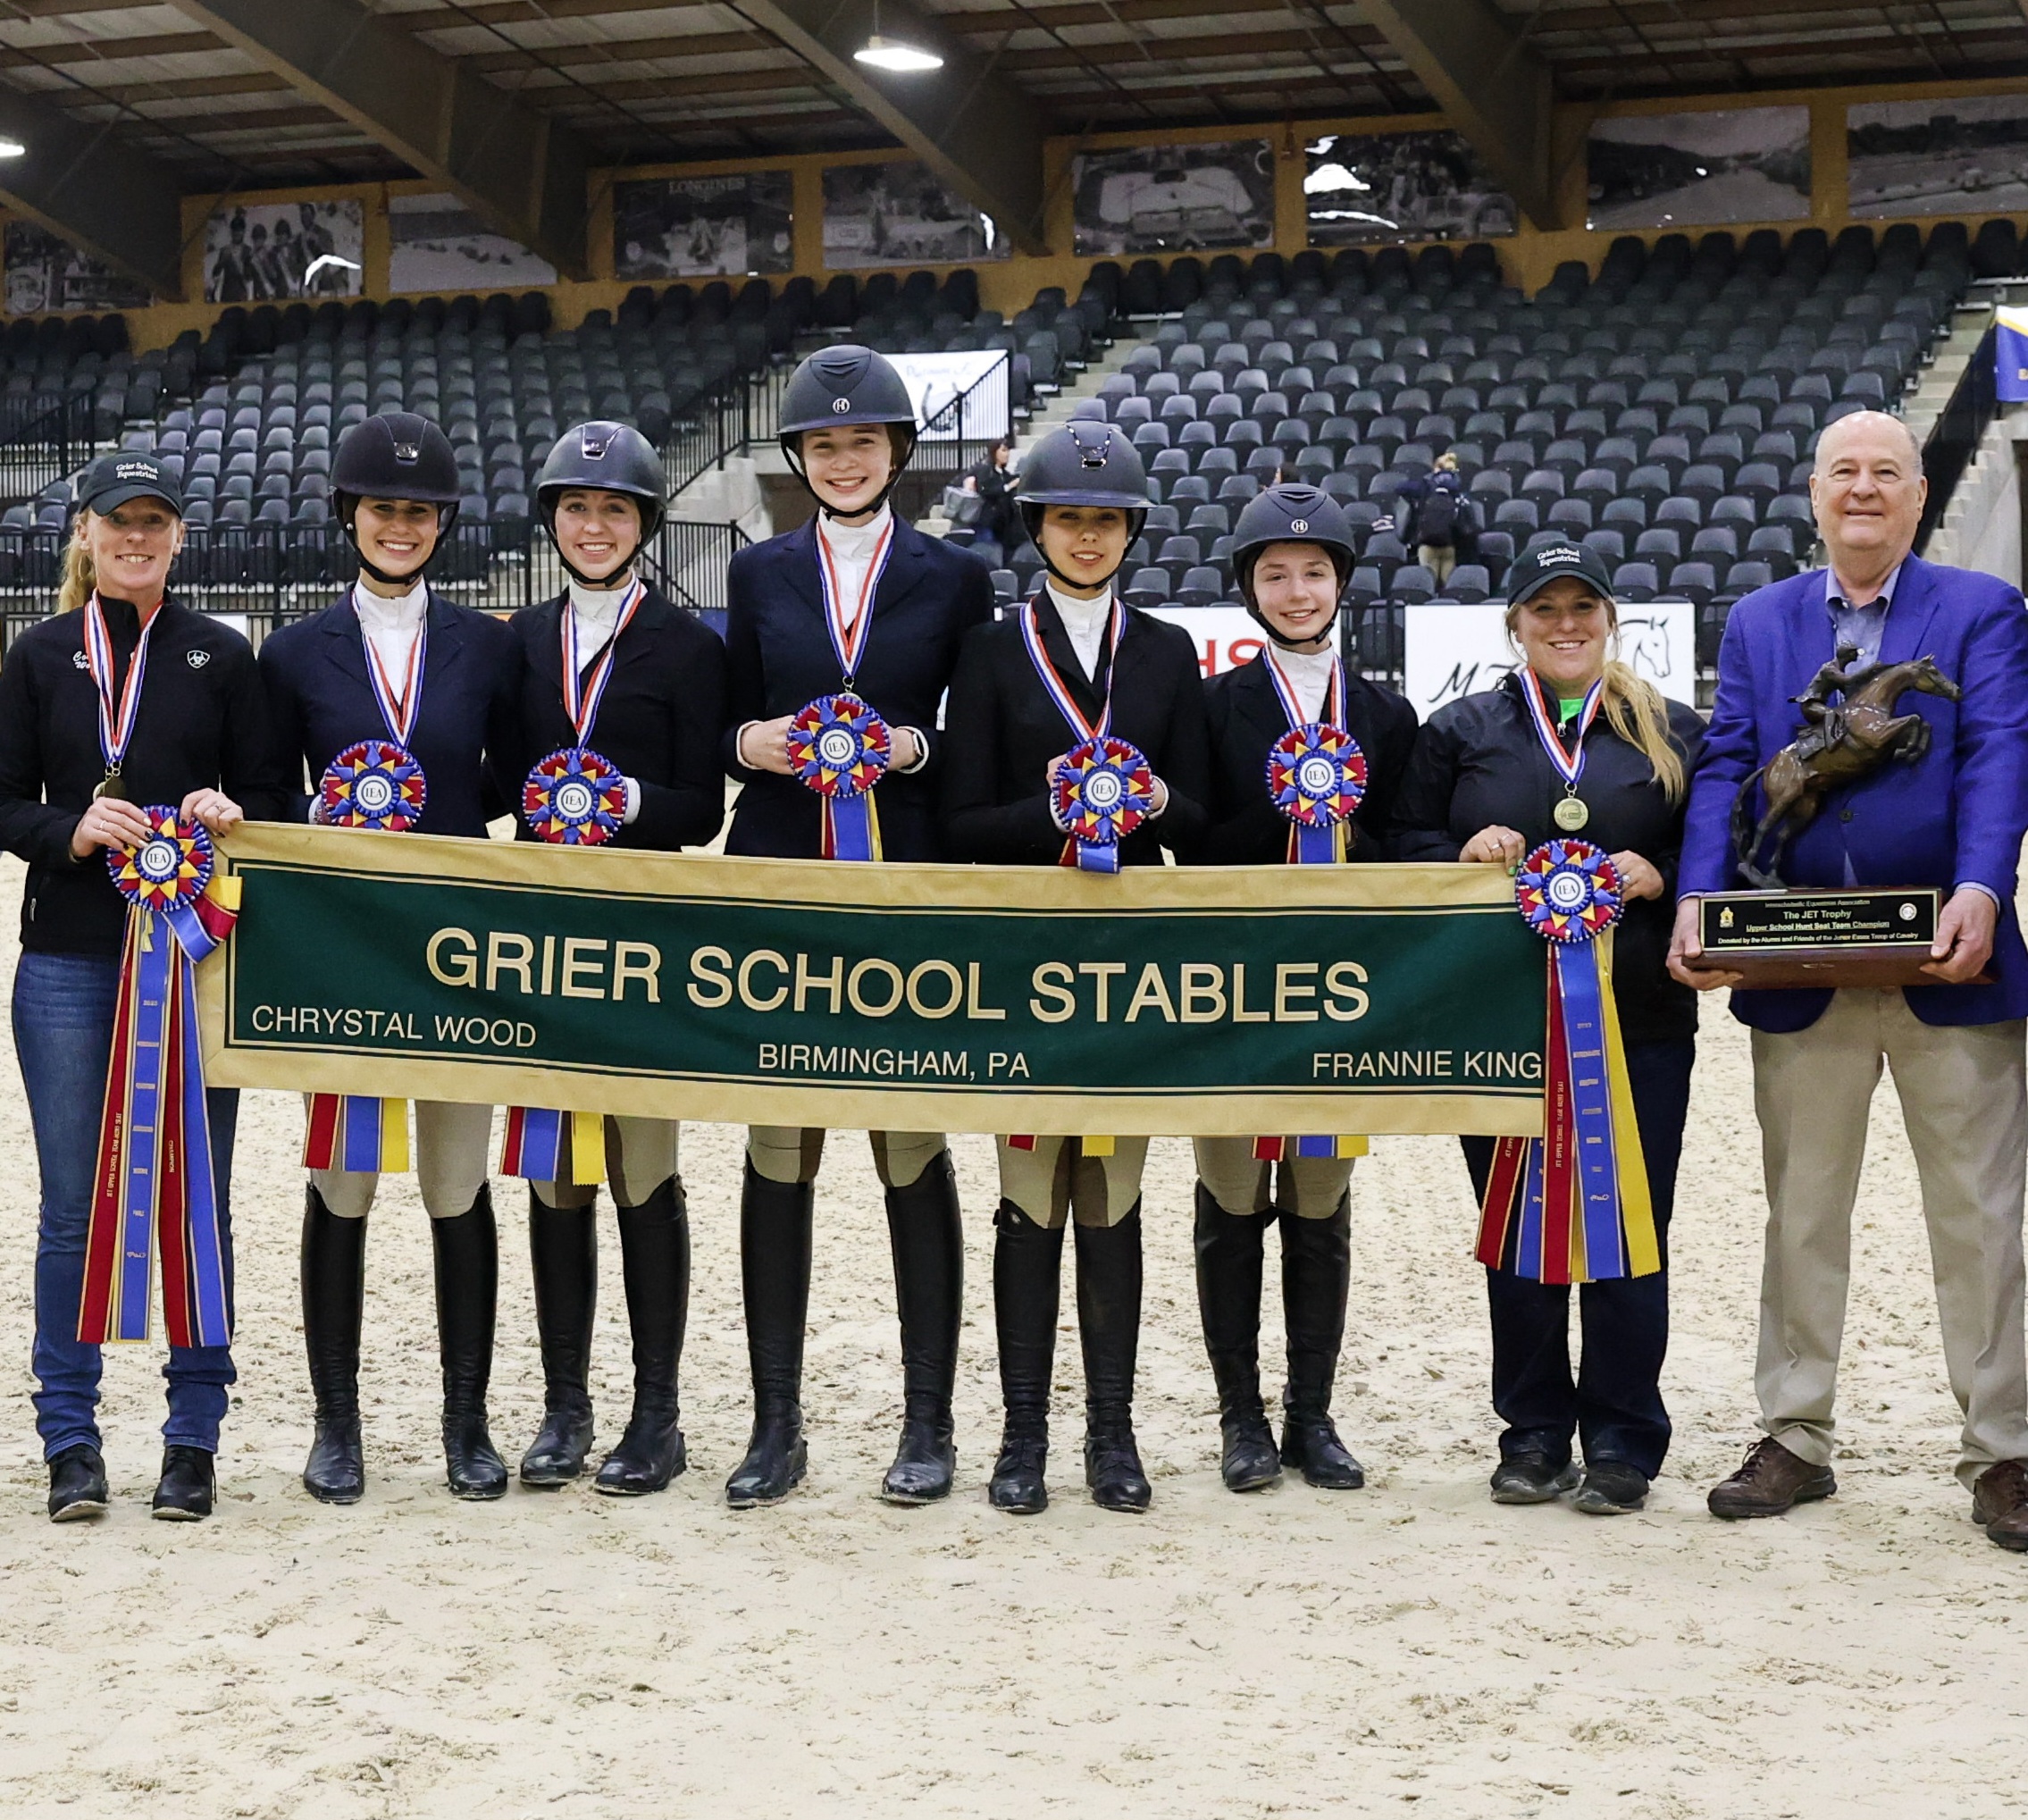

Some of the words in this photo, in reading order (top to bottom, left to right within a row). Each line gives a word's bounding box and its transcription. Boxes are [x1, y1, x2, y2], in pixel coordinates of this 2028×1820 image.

[115, 463, 135, 471] Grier
[136, 461, 159, 474] School
[116, 470, 157, 481] Equestrian
[1537, 549, 1555, 560] Grier
[1539, 555, 1581, 567] Equestrian
[828, 742, 845, 752] IEA
[1309, 770, 1326, 781] IEA
[365, 787, 382, 798] IEA
[1095, 784, 1112, 794] IEA
[565, 795, 582, 806] IEA
[149, 853, 167, 863] IEA
[1558, 885, 1576, 894] IEA
[1783, 911, 1799, 919] The
[1801, 910, 1819, 919] JET
[1821, 910, 1852, 919] Trophy
[1746, 925, 1768, 933] Upper
[1769, 923, 1794, 931] School
[1852, 921, 1890, 929] Champion
[1742, 937, 1750, 945] by
[425, 927, 661, 1003] GRIER
[686, 945, 1006, 1019] SCHOOL
[1028, 960, 1370, 1024] STABLES
[251, 1004, 423, 1040] CHRYSTAL
[434, 1014, 537, 1048] WOOD
[758, 1043, 976, 1082] BIRMINGHAM,
[987, 1052, 1030, 1078] PA
[1312, 1050, 1453, 1078] FRANNIE
[1463, 1050, 1542, 1079] KING
